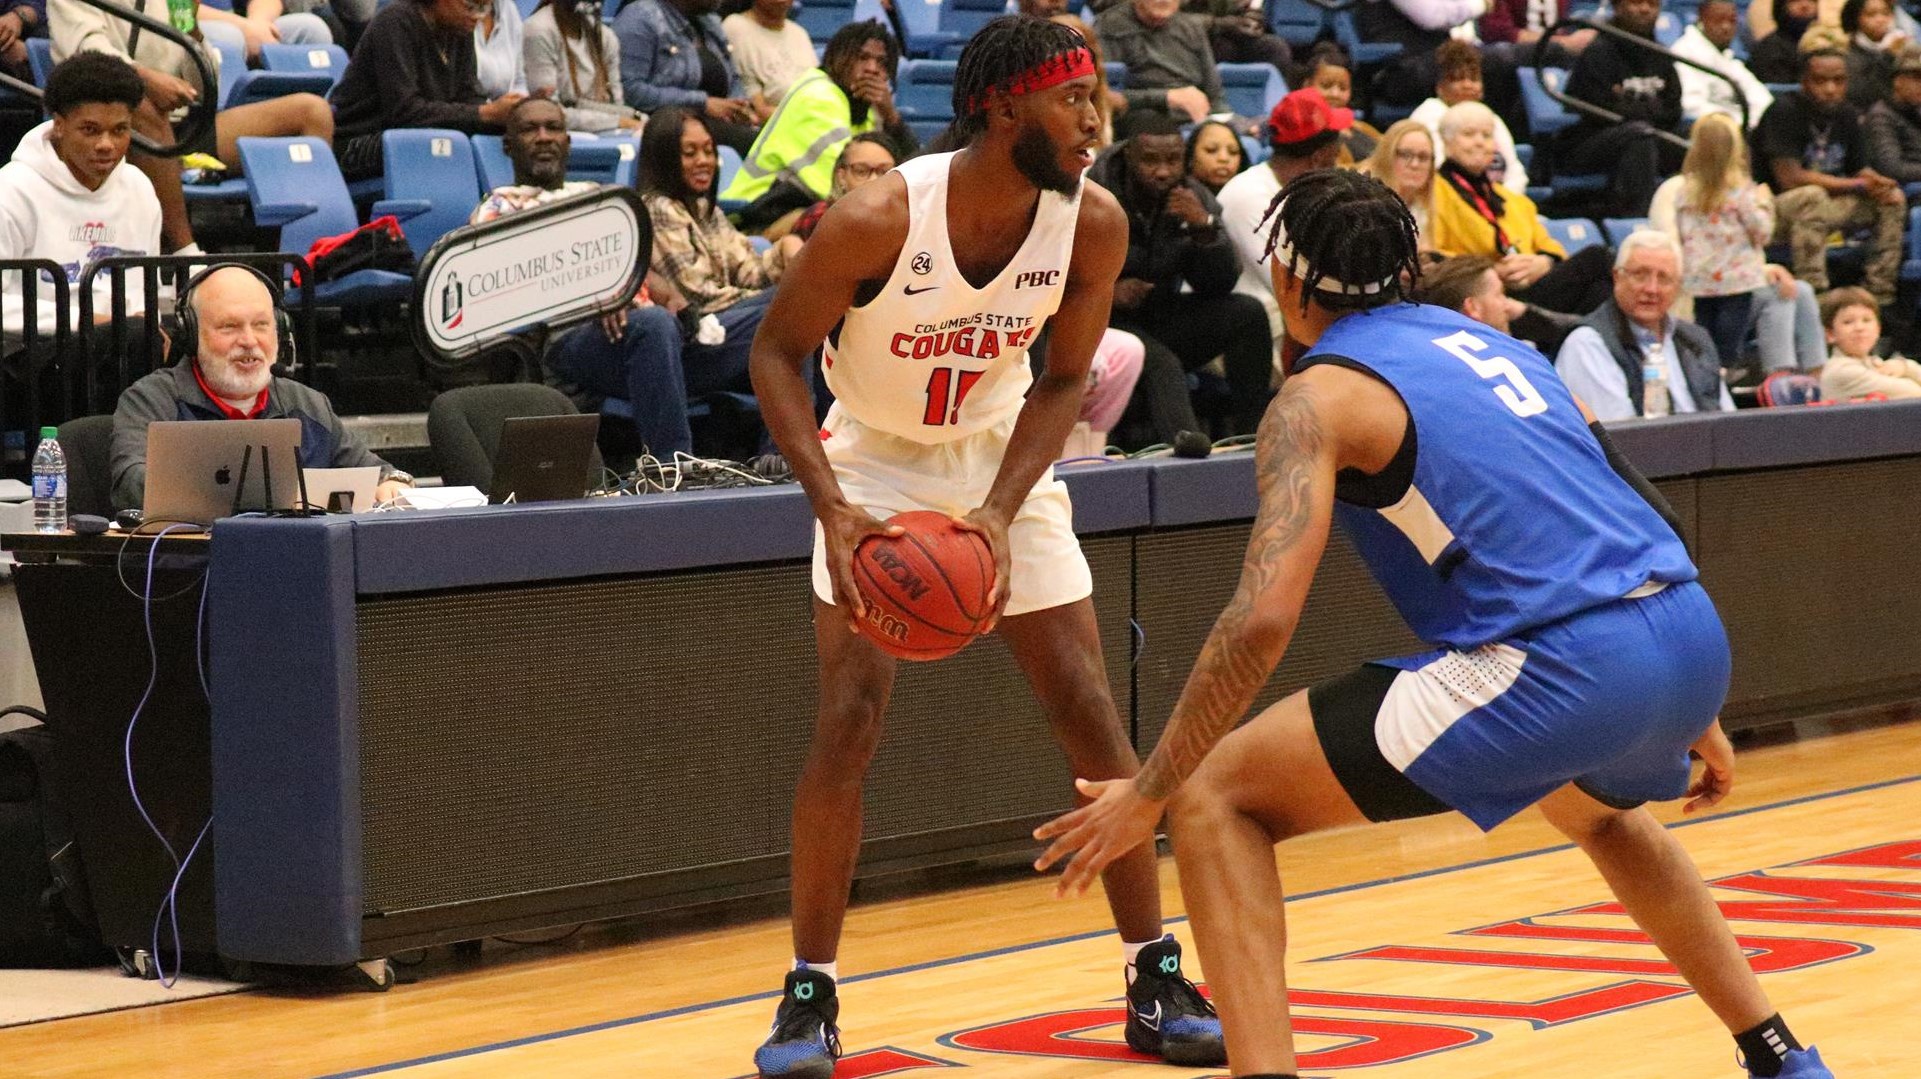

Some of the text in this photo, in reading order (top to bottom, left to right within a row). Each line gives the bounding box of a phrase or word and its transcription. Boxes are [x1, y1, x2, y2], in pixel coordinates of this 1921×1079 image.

[467, 231, 623, 297] COLUMBUS STATE
[540, 255, 622, 292] UNIVERSITY
[914, 256, 930, 272] 24
[1015, 270, 1060, 289] PBC
[914, 312, 1033, 334] COLUMBUS STATE
[1431, 330, 1549, 418] 5
